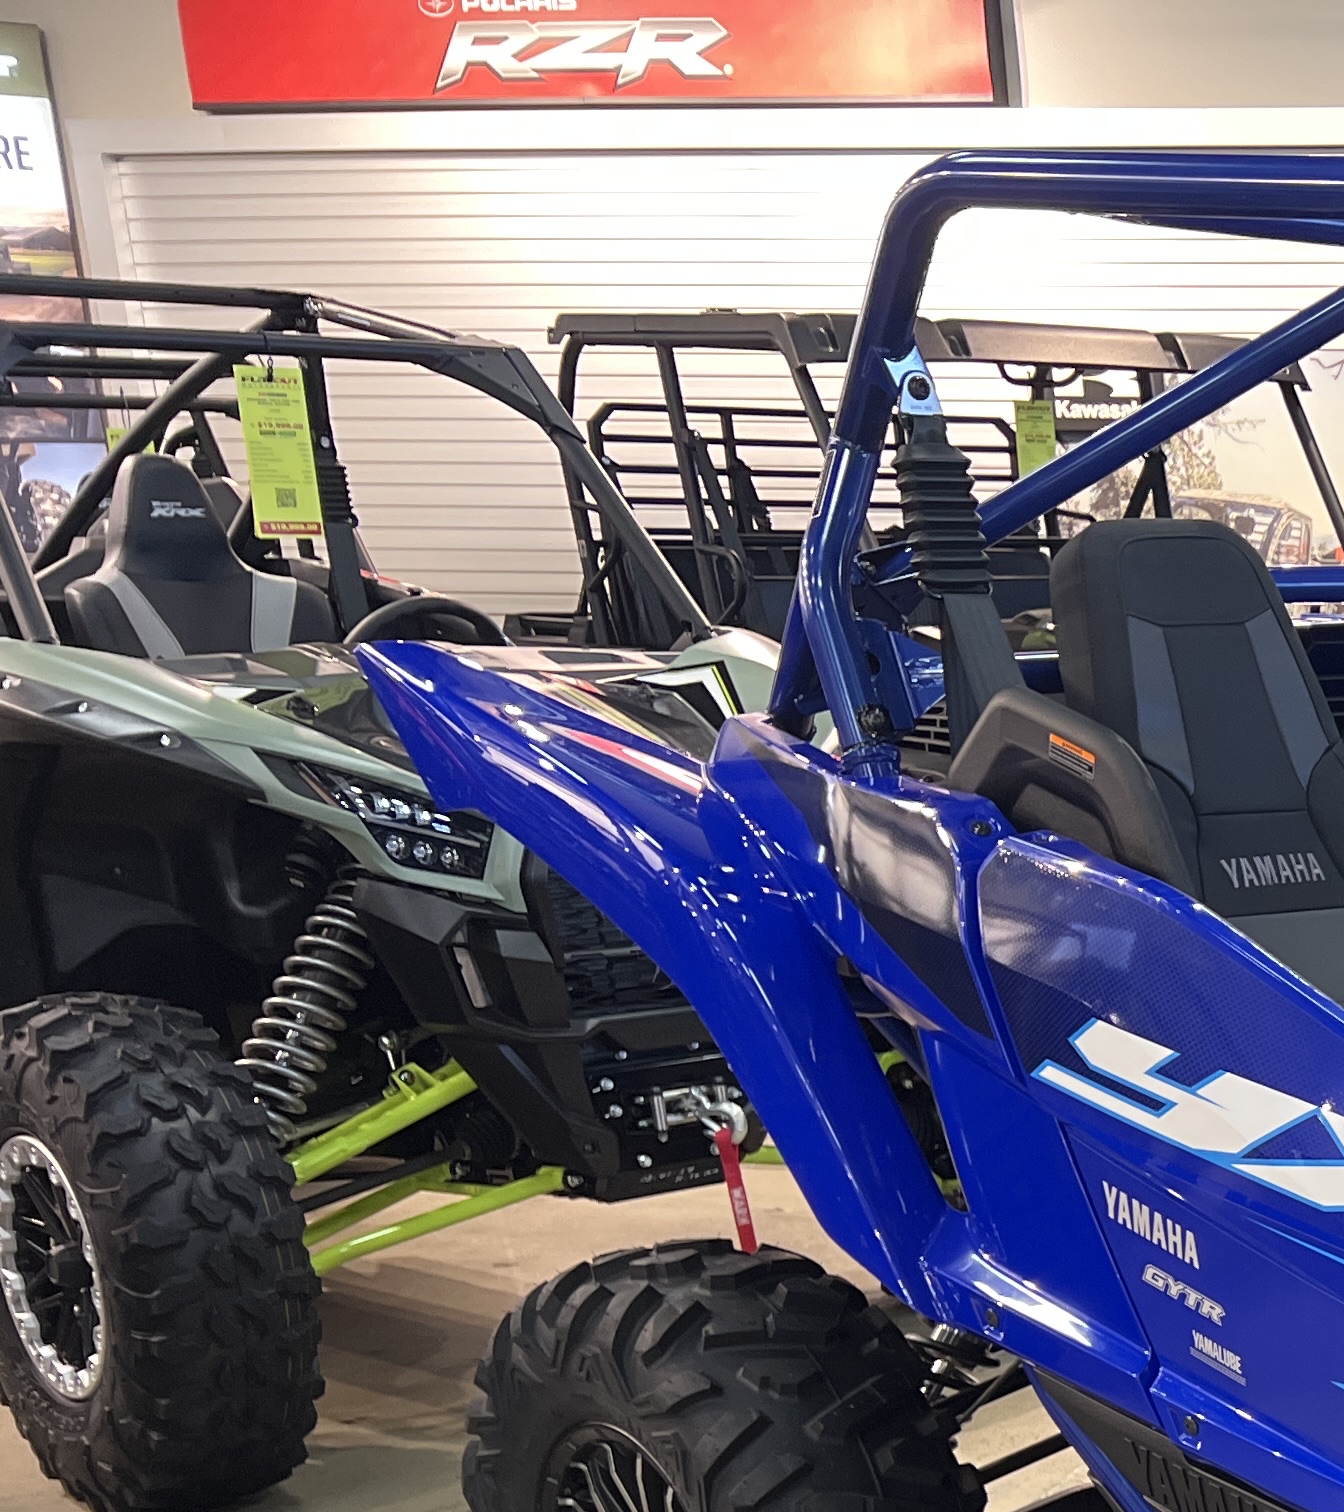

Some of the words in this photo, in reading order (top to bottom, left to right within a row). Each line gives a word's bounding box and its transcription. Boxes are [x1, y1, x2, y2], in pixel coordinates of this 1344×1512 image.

[433, 17, 731, 94] RZR
[1055, 399, 1141, 419] Kawasak
[1220, 853, 1325, 888] YAMAHA
[1102, 1180, 1200, 1270] YAMAHA
[1142, 1263, 1227, 1327] GYTR
[1191, 1329, 1243, 1375] YAMALUBE
